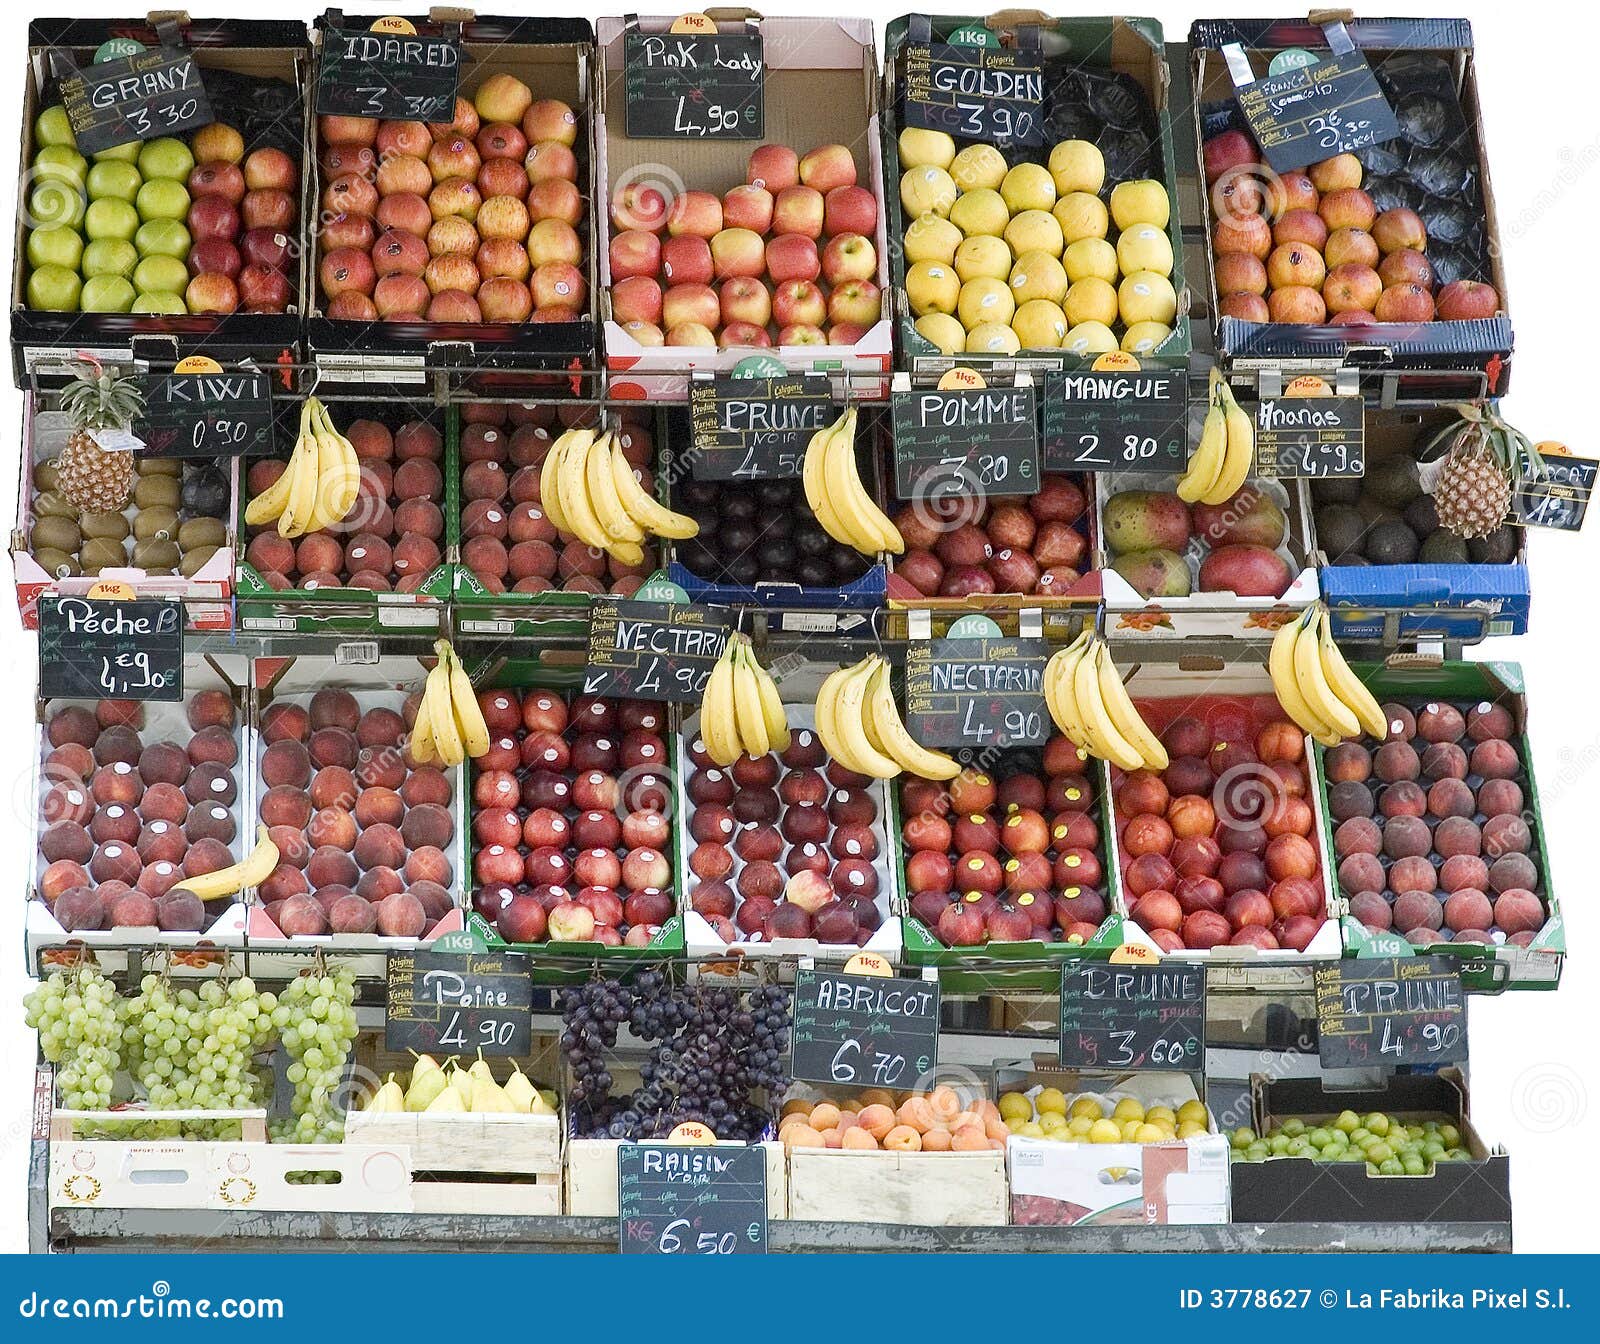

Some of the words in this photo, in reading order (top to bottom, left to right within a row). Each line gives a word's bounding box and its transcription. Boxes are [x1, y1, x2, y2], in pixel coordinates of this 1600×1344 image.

[684, 16, 705, 28] 1kg
[959, 31, 987, 46] 1Kg
[110, 42, 137, 56] 1Kg
[343, 36, 457, 67] IDARED
[906, 47, 931, 59] Origine
[713, 44, 763, 82] Lady
[907, 60, 930, 72] Produit
[1278, 54, 1307, 68] 1Kg
[92, 61, 193, 110] GRANY
[934, 66, 1043, 101] GOLDEN
[907, 89, 930, 101] Calibre
[955, 371, 976, 385] 1kg
[166, 377, 259, 402] KIWI
[691, 387, 717, 399] Origine
[1064, 376, 1171, 400] MANGUE
[692, 401, 717, 414] Produit
[920, 394, 1028, 428] POMME
[721, 401, 827, 432] PRUNE
[1259, 400, 1341, 431] Ananas
[693, 417, 718, 431] Variété
[695, 433, 719, 446] Calibre
[753, 432, 797, 446] NOIR
[98, 584, 121, 594] 1kg
[646, 586, 675, 600] 1Kg
[592, 606, 618, 619] Origine
[591, 621, 615, 634] Produit
[958, 621, 989, 635] 1Kg
[588, 651, 613, 664] Calibre
[906, 647, 932, 660] Origine
[443, 936, 473, 949] 1Kg
[1370, 939, 1400, 954] 1Kg
[1124, 945, 1146, 958] 1kg
[389, 958, 415, 970] Origine
[858, 956, 880, 970] 1kg
[389, 973, 414, 986] Produit
[1315, 968, 1341, 982] Origine
[1080, 967, 1200, 1001] PRUNE
[1344, 980, 1459, 1017] PRUNE
[389, 1006, 414, 1018] Calibre
[680, 1127, 703, 1139] 1kg
[643, 1150, 735, 1174] RAISIN
